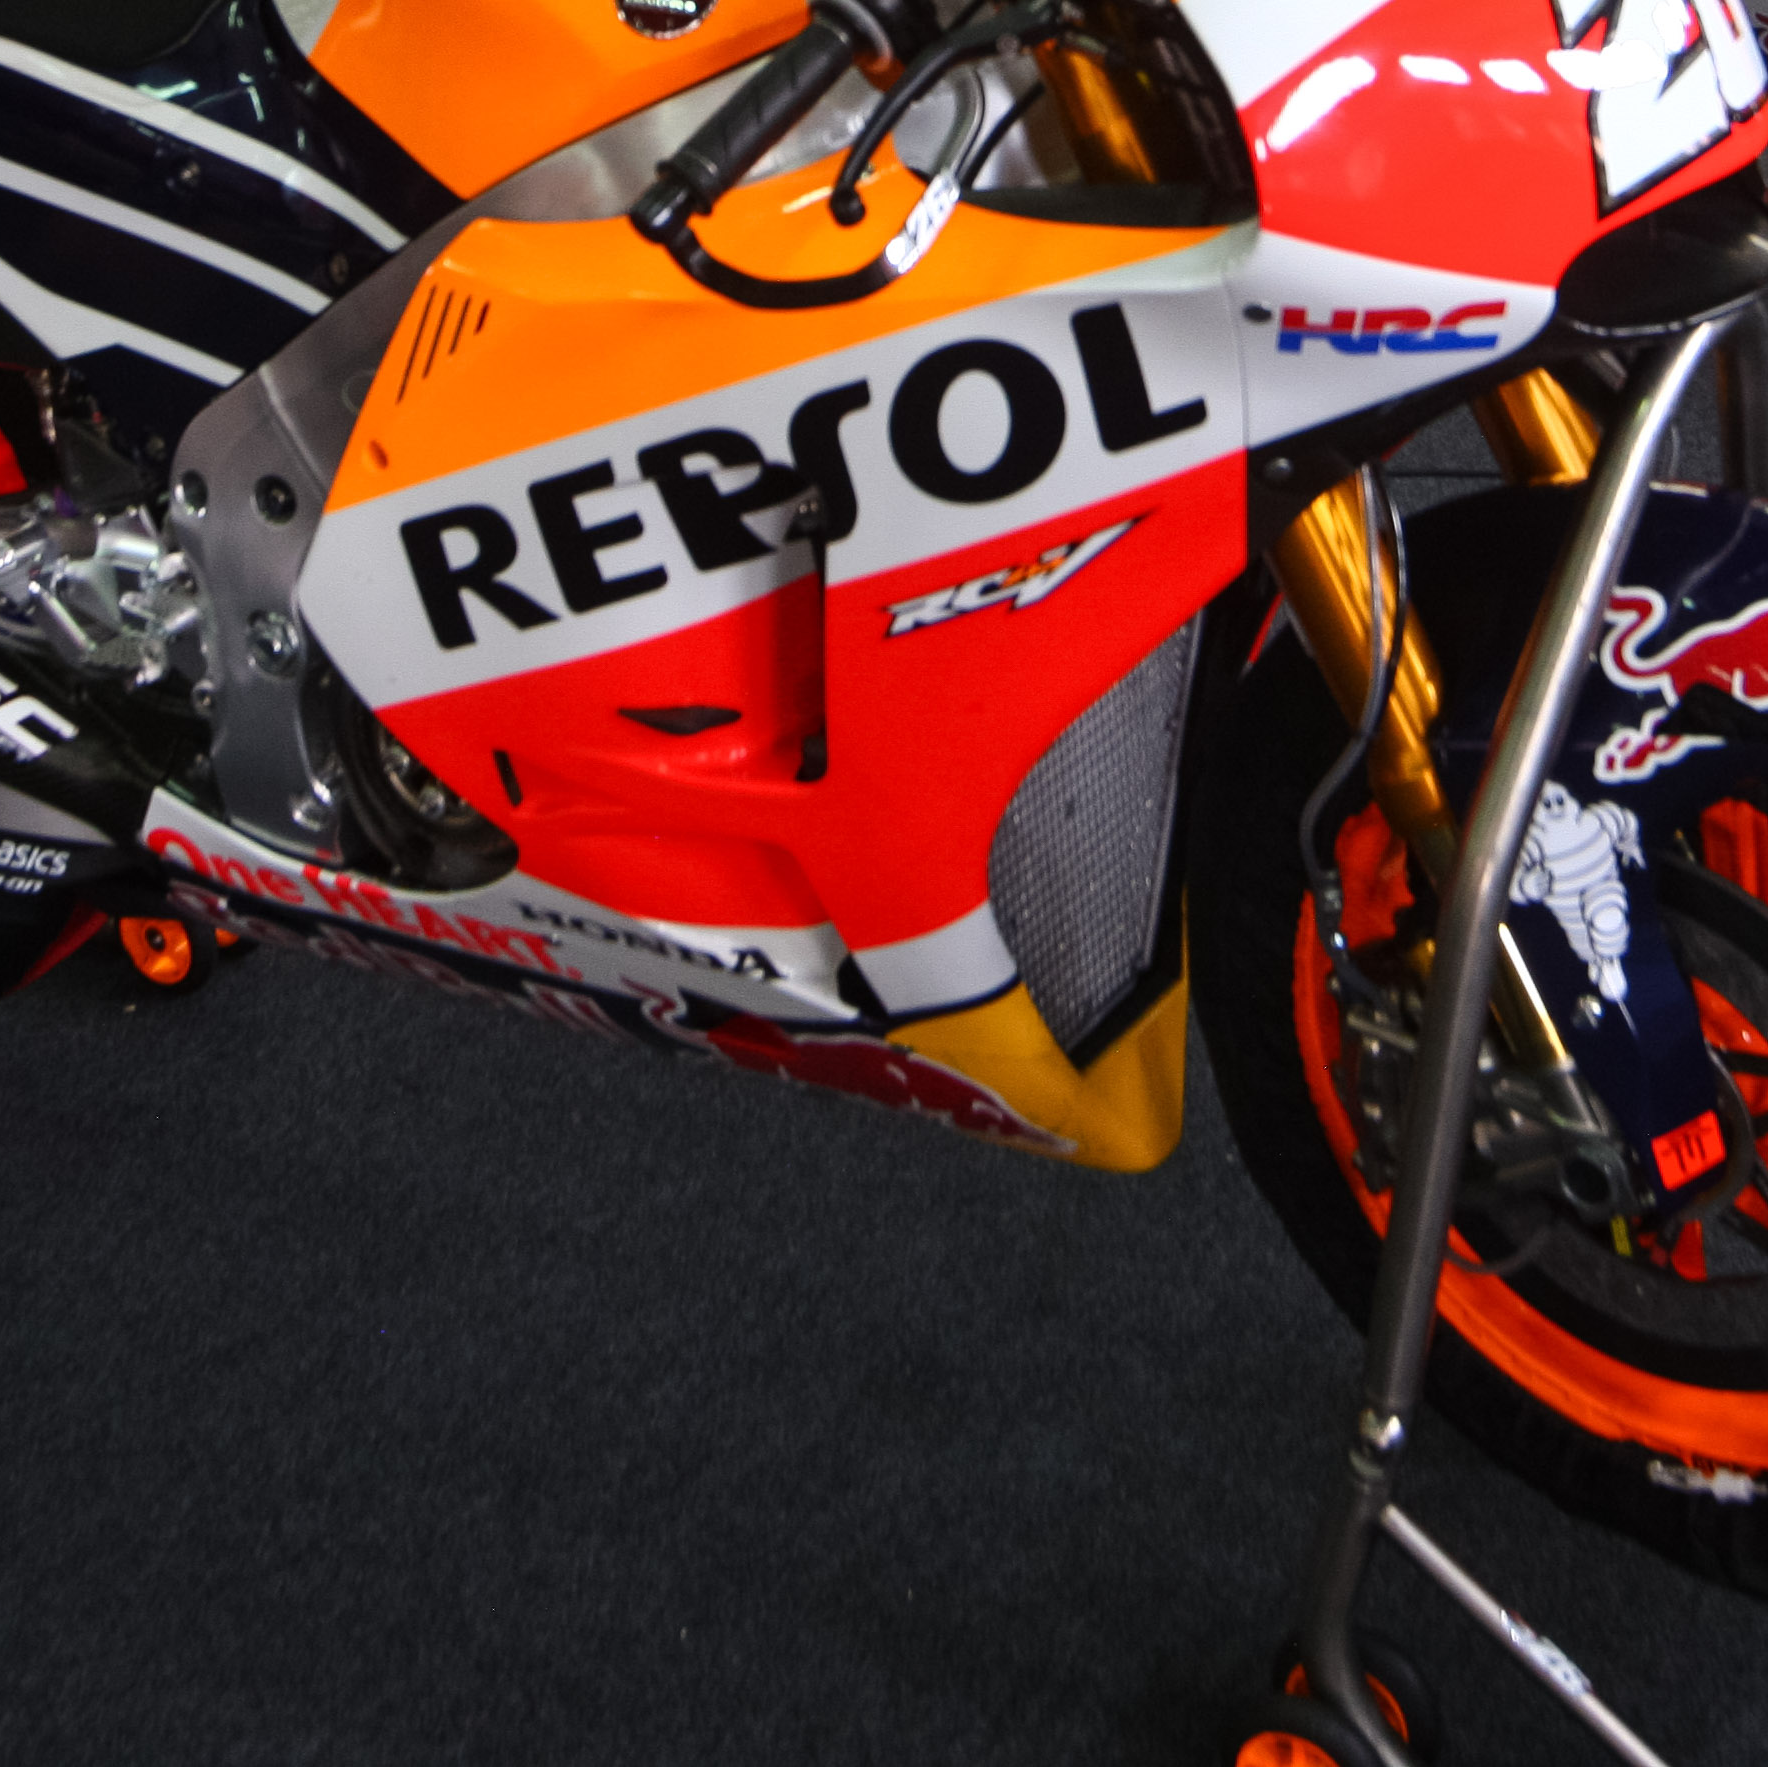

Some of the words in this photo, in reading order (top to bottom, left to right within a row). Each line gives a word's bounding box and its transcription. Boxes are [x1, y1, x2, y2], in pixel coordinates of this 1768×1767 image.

[1276, 300, 1507, 354] HRC
[399, 300, 1208, 650] REPSOL
[512, 897, 790, 982] HONDA
